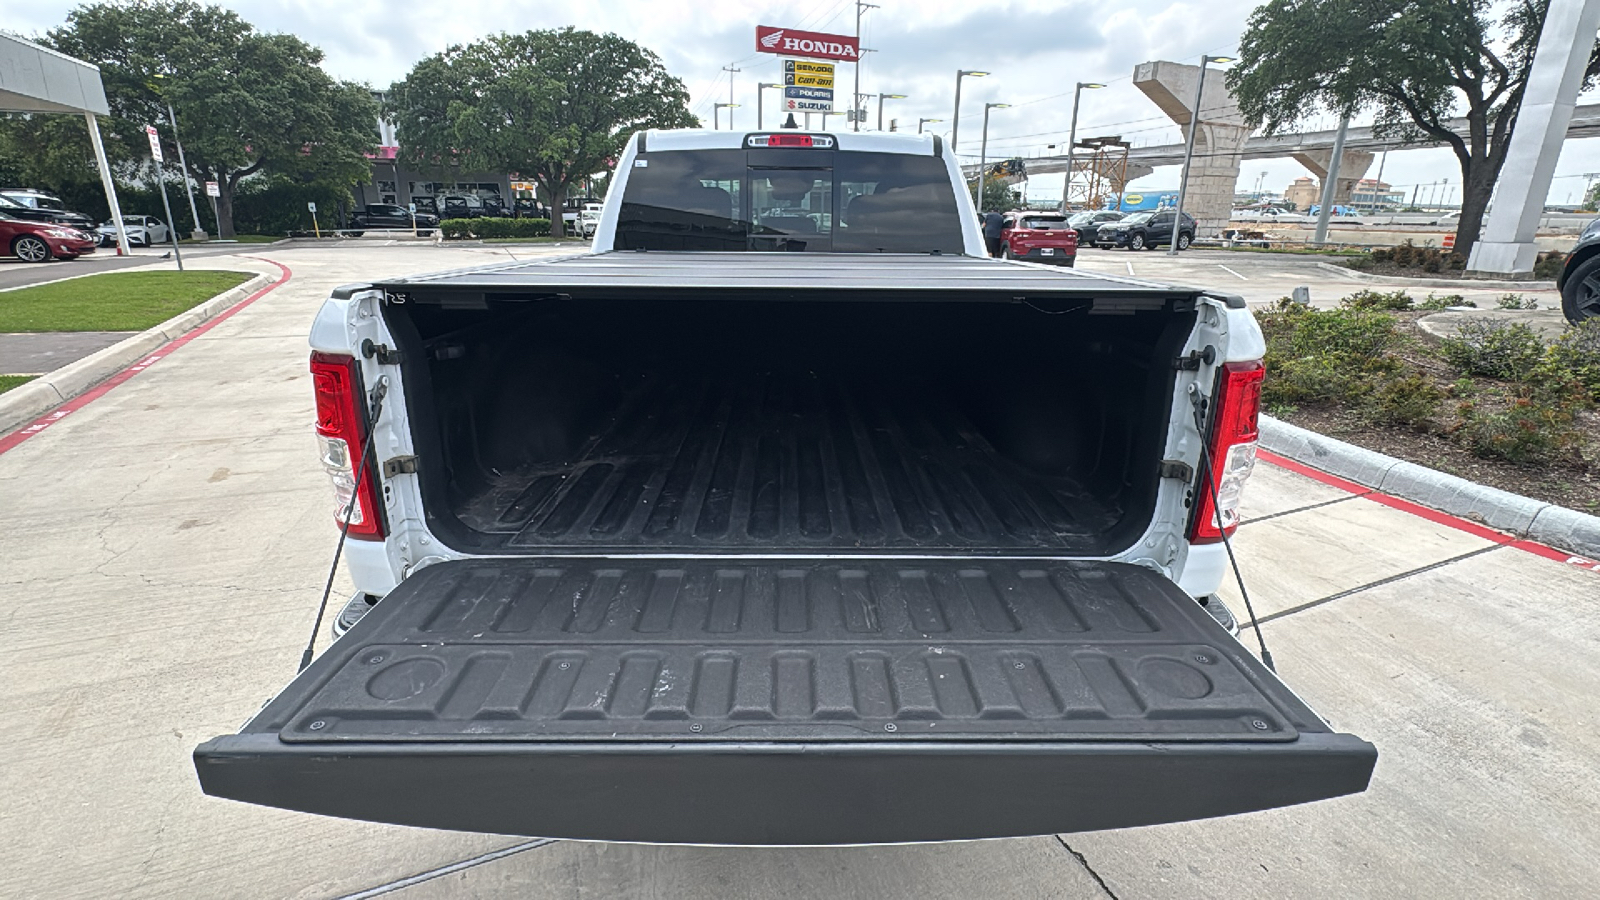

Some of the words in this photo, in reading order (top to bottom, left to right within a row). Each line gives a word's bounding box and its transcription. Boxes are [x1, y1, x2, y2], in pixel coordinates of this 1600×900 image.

[783, 37, 857, 57] HONDA
[799, 89, 831, 99] POLARIS
[797, 101, 831, 111] SUZUKI
